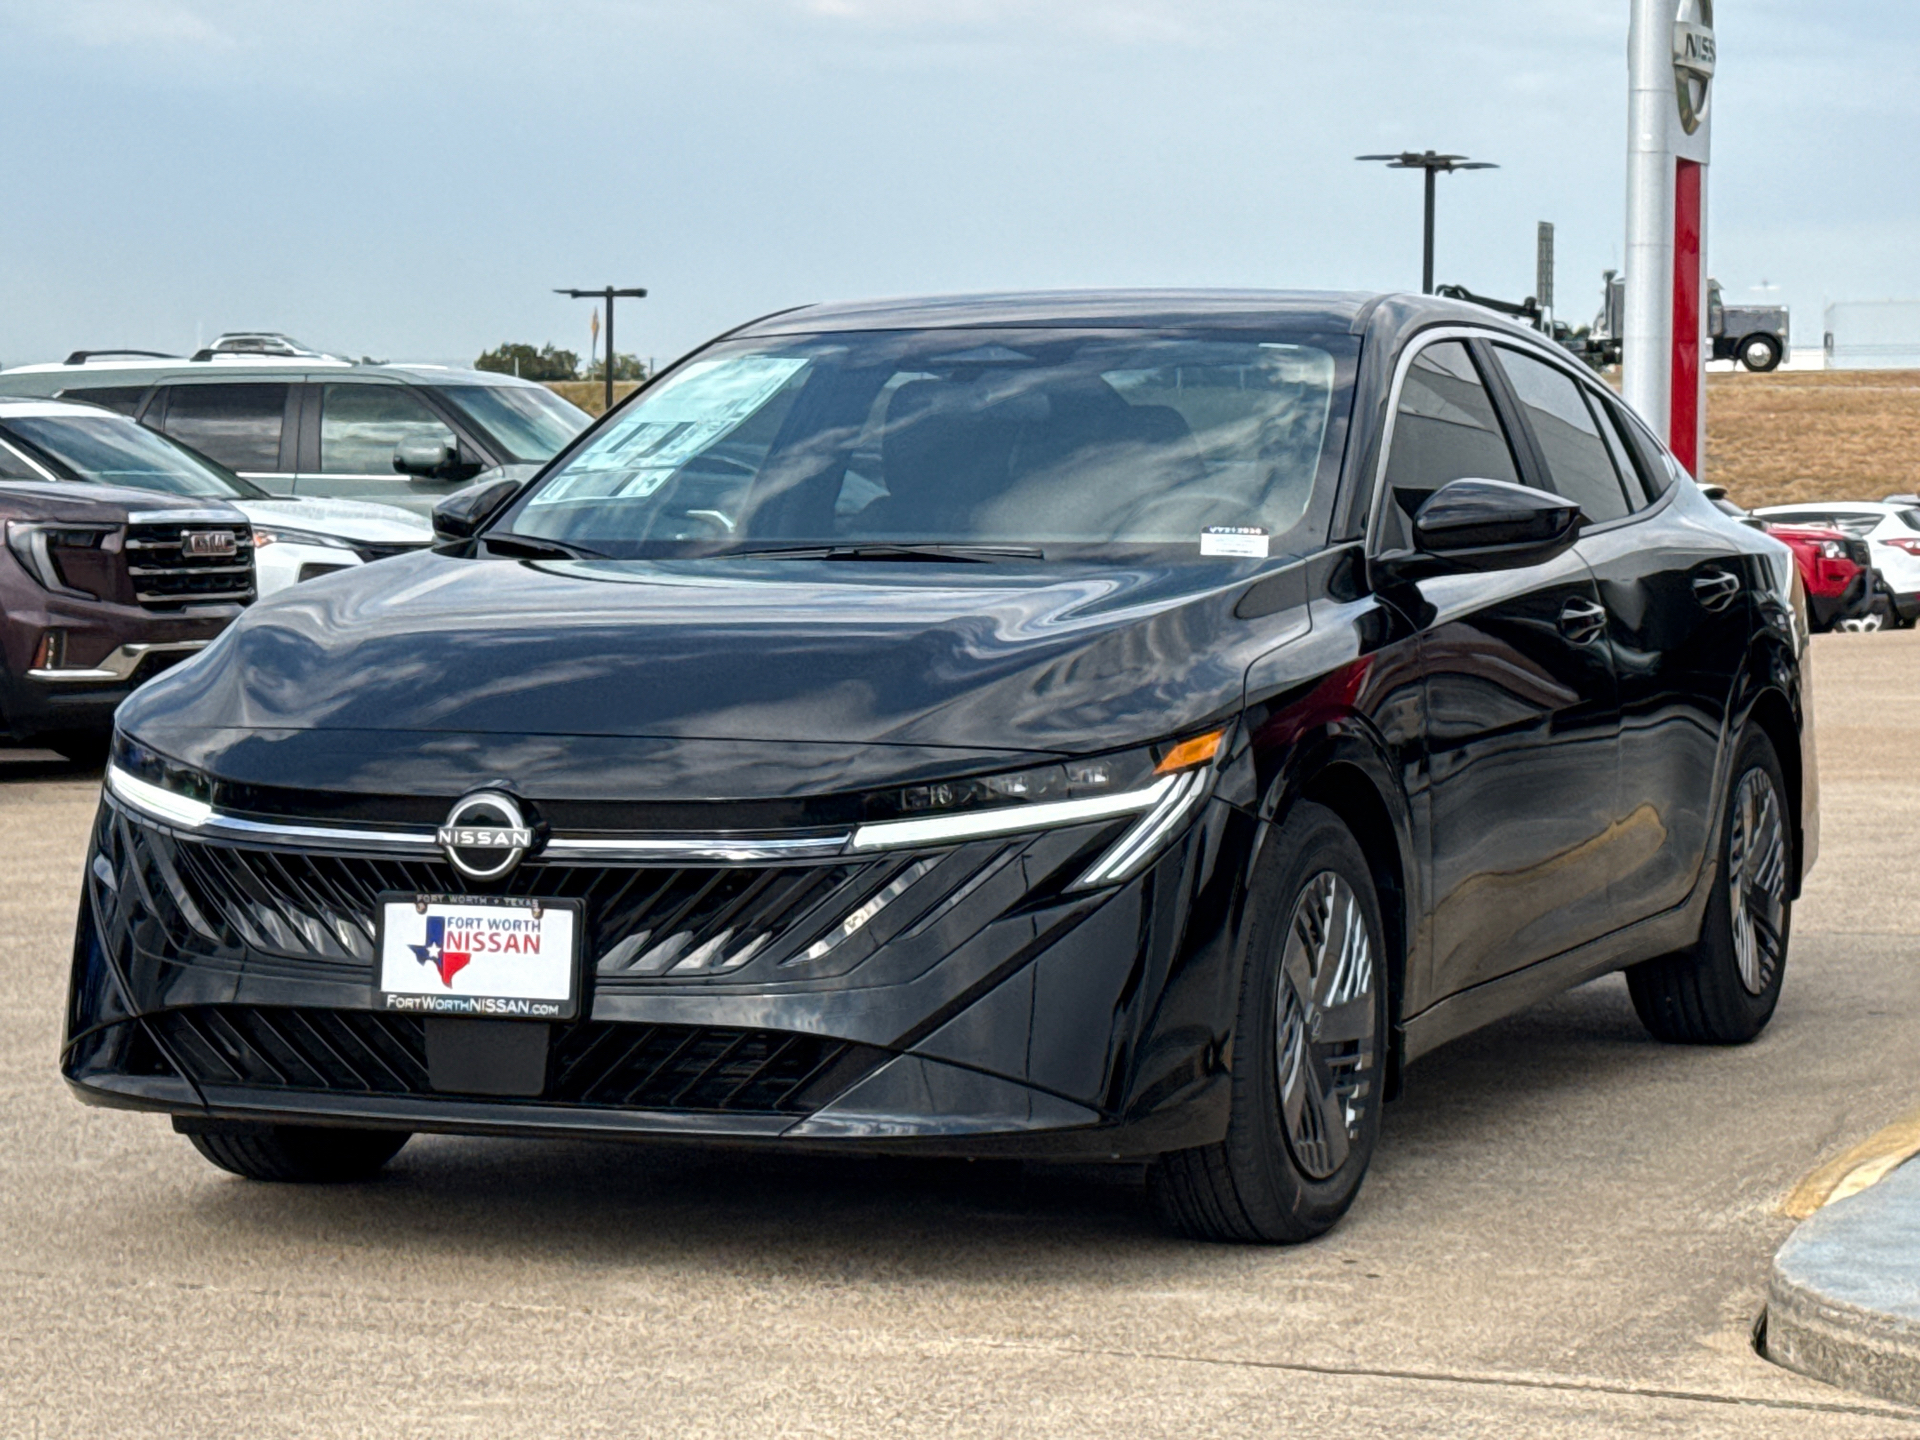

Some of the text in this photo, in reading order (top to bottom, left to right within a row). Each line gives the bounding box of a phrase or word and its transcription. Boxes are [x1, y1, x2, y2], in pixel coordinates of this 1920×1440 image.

[190, 533, 236, 553] GMC
[438, 829, 529, 846] NISSAN
[416, 894, 539, 908] FORT WORTH TEXAS
[447, 916, 541, 933] FORT WORTH
[446, 931, 541, 954] NISSAN
